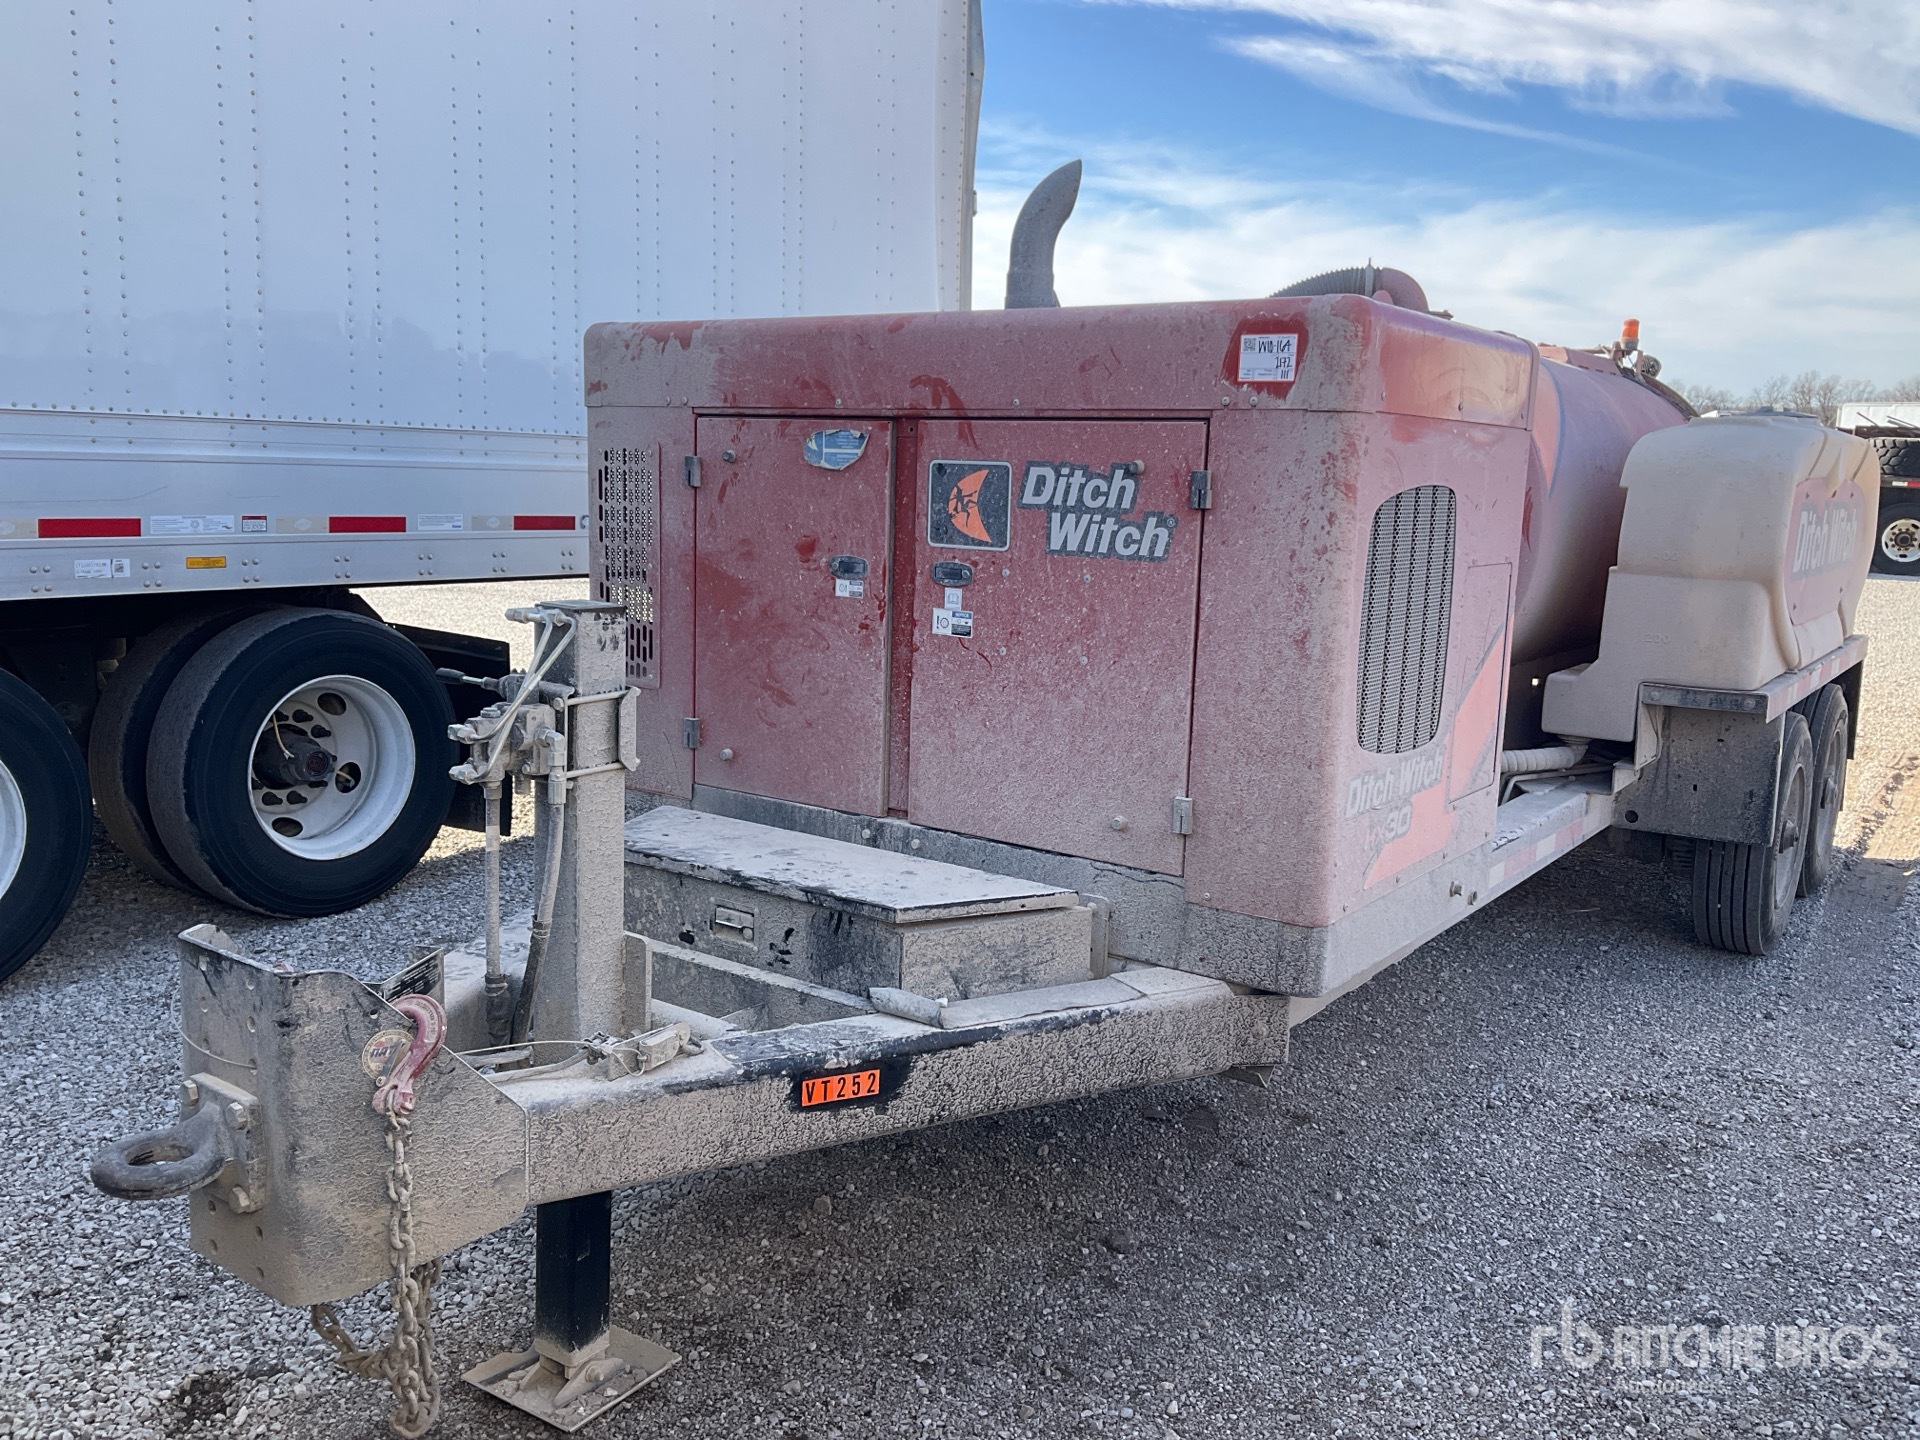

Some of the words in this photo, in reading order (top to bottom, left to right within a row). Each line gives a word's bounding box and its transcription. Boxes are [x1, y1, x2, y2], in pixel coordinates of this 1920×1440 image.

[1022, 466, 1136, 509] Ditch
[1049, 512, 1170, 557] Witch
[1792, 508, 1829, 573] Ditch
[1345, 767, 1395, 818] Ditch
[1400, 749, 1444, 797] Witch
[806, 1073, 876, 1103] VT252
